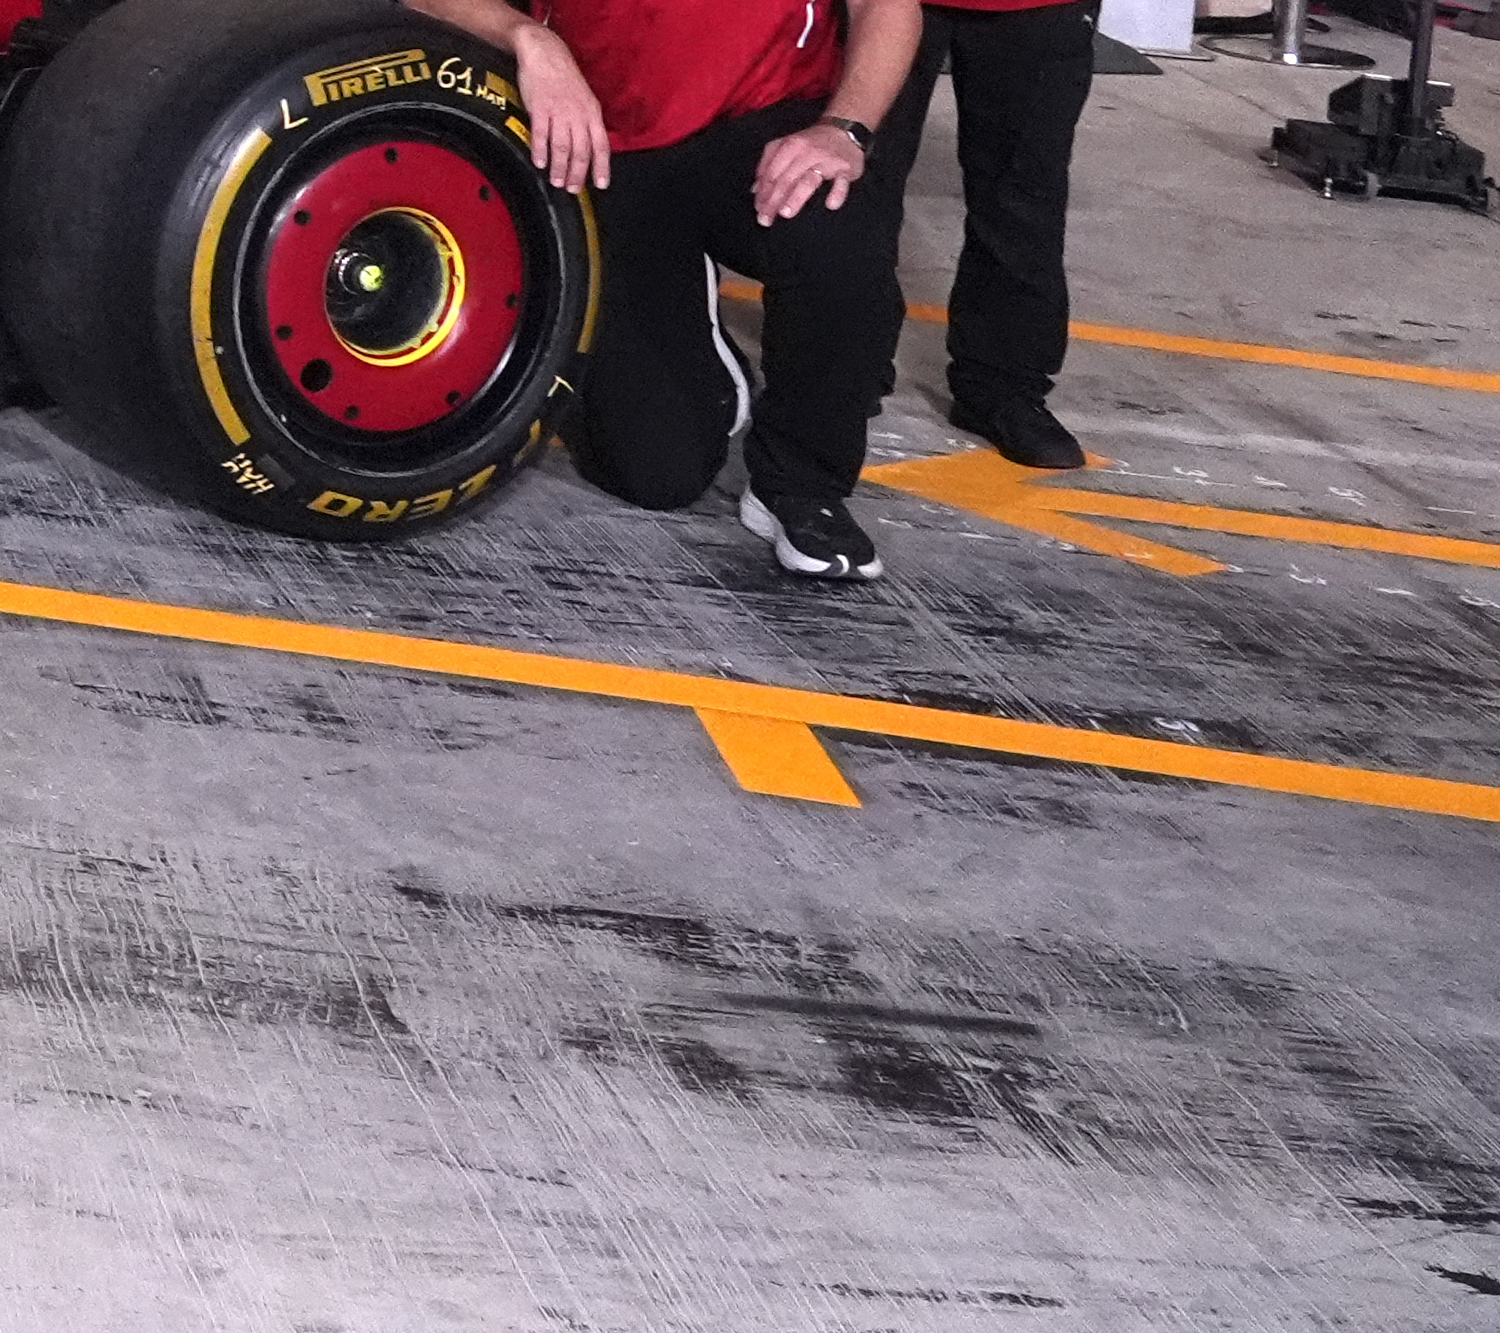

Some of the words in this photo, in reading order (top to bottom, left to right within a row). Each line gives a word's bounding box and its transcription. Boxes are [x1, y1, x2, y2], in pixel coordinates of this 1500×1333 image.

[303, 47, 432, 108] PIRELLI
[436, 56, 474, 96] 61
[306, 464, 498, 523] ZERO
